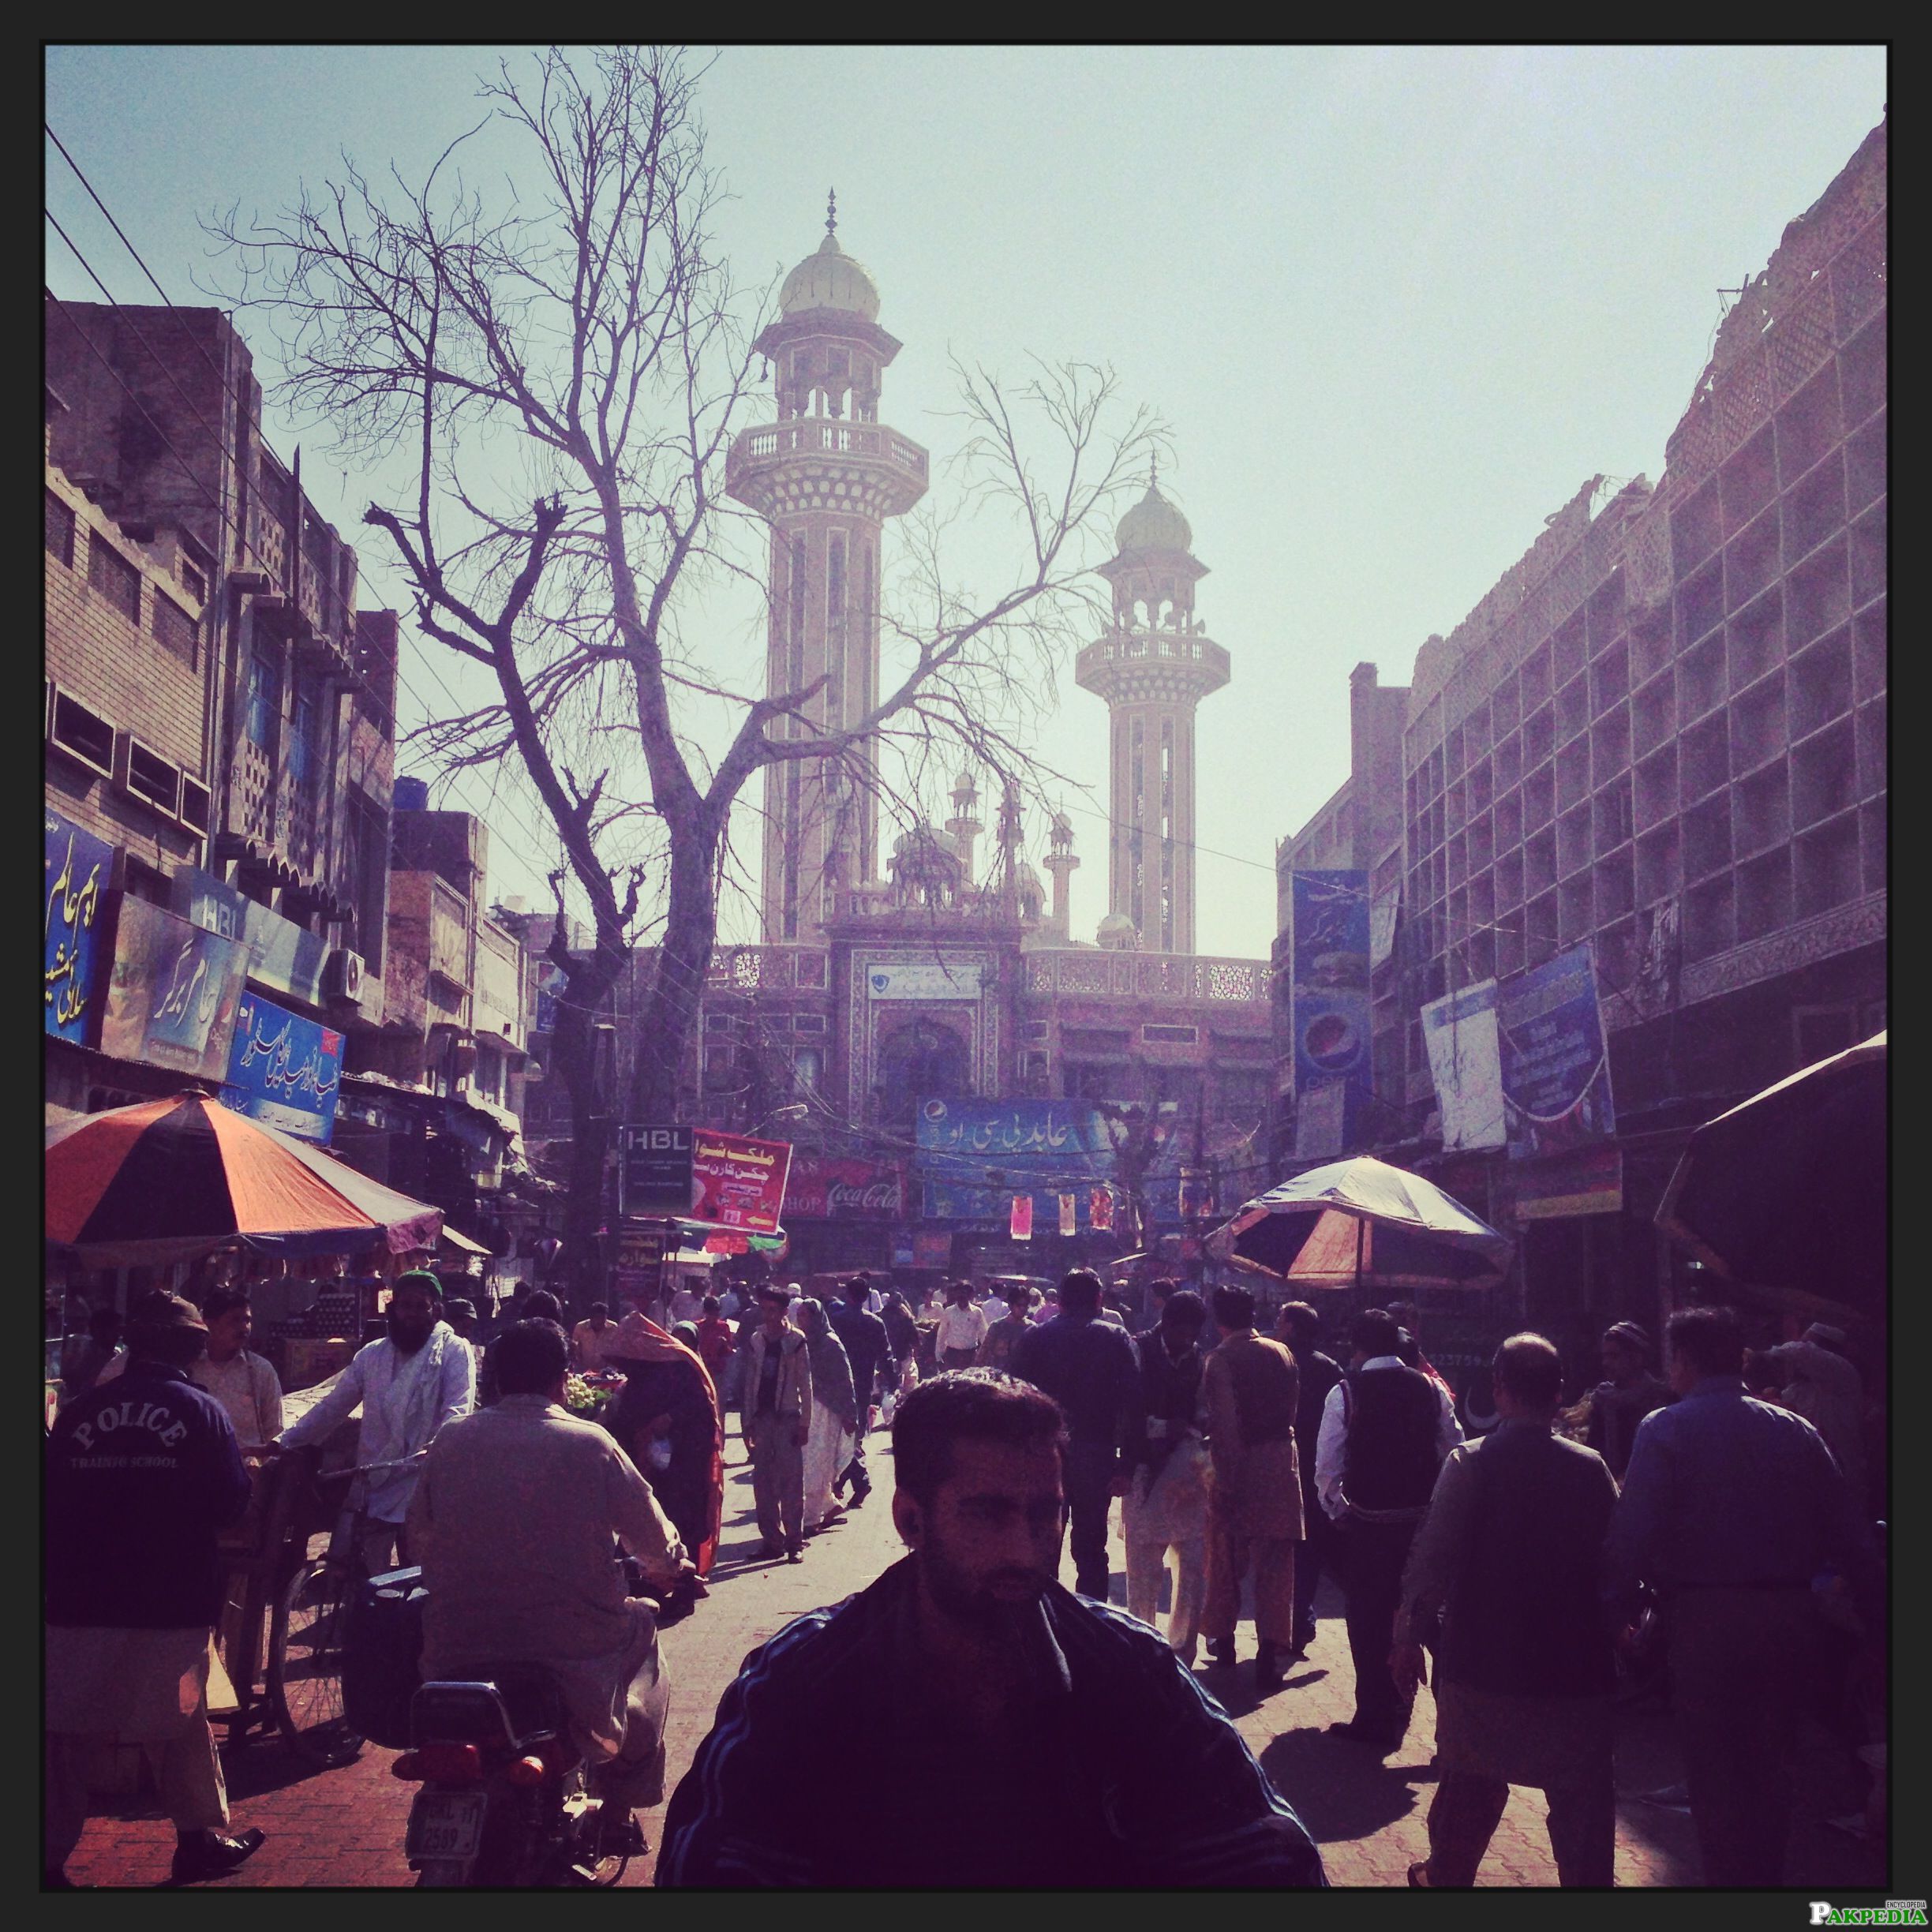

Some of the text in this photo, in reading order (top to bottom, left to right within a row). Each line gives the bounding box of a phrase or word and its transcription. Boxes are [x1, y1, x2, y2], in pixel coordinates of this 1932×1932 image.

[628, 1130, 690, 1150] HBL
[695, 1138, 727, 1159] شوا
[71, 1402, 188, 1450] POLICE
